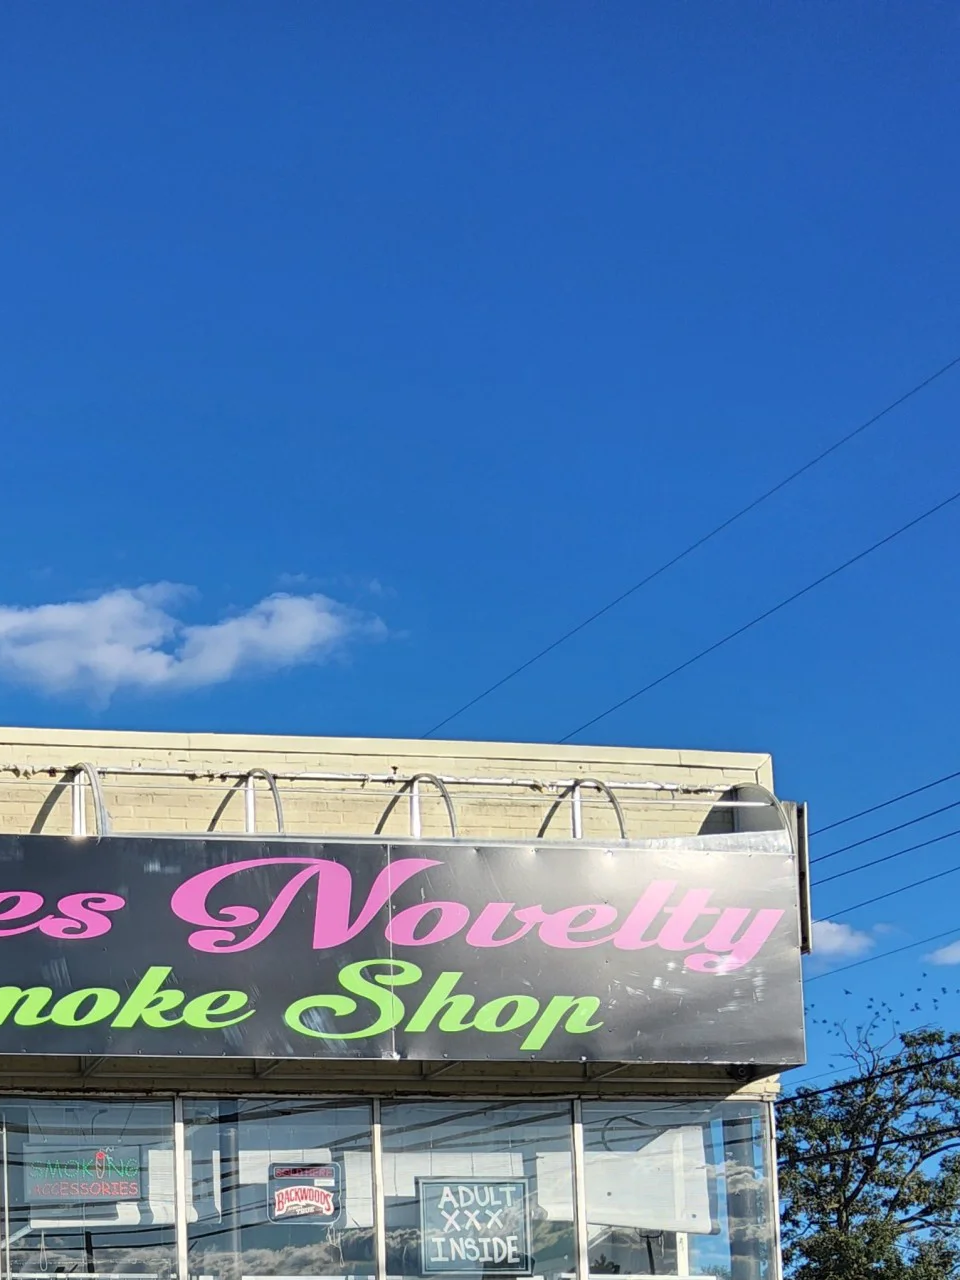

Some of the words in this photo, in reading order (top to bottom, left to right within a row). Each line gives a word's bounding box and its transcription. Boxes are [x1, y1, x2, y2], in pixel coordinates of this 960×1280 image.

[170, 857, 785, 973] Novelty
[284, 959, 604, 1051] Shop
[32, 1181, 138, 1196] ACCESSORIES
[275, 1187, 333, 1214] BACKWOODS
[437, 1185, 517, 1209] ADULT
[440, 1208, 504, 1233] XXX
[430, 1235, 521, 1264] INSIDE
